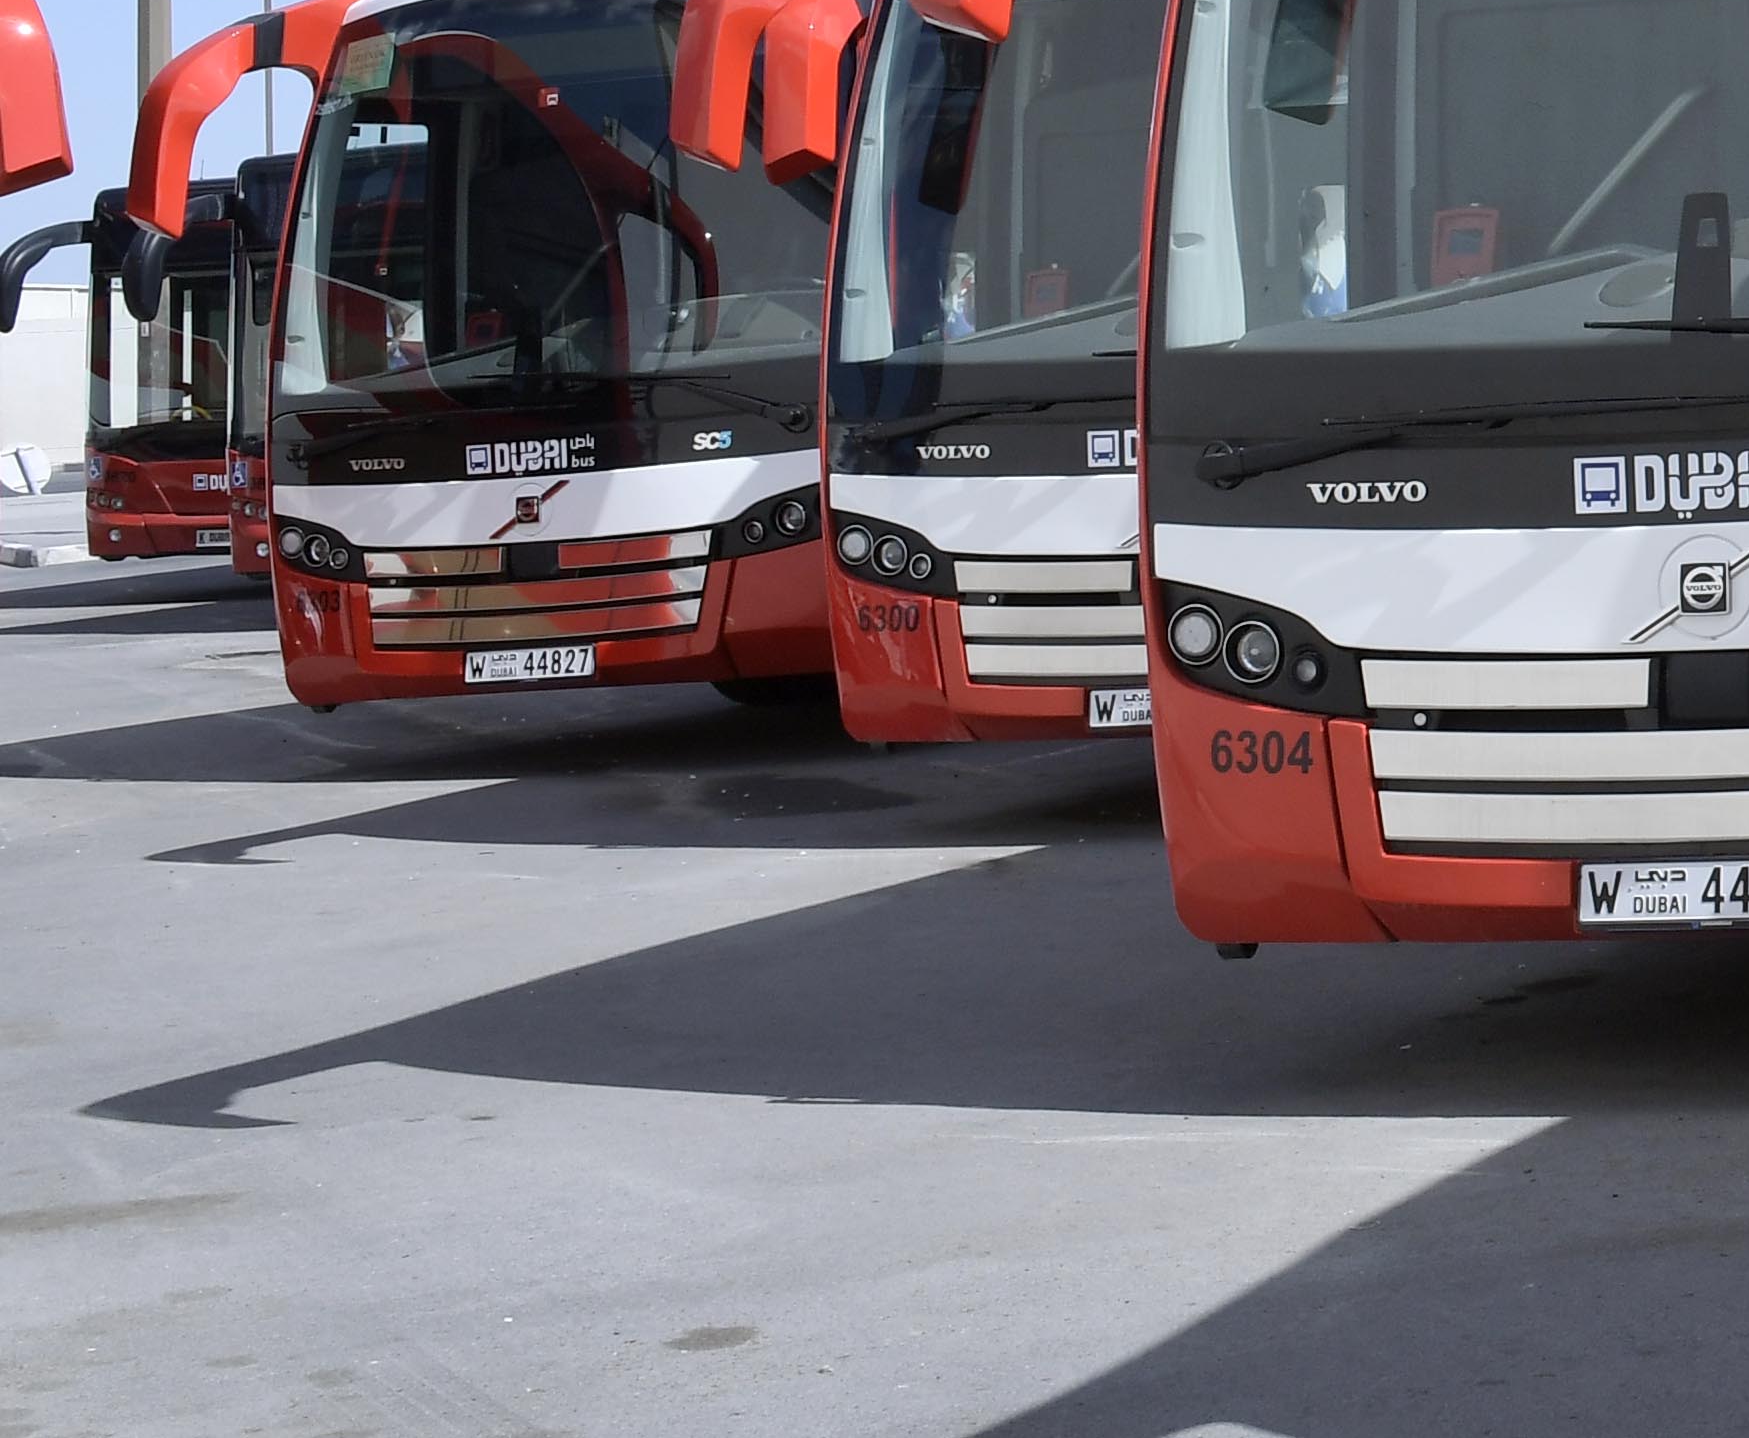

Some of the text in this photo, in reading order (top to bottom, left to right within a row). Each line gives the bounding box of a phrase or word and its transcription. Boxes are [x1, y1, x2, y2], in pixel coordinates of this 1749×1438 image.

[570, 433, 595, 451] باص
[692, 430, 733, 451] SC5
[494, 438, 568, 476] DUBAI
[571, 455, 595, 468] bus
[916, 444, 991, 460] VOLVO
[349, 458, 405, 471] VOLVO
[1307, 480, 1427, 505] VOLVO
[1685, 584, 1721, 592] VOLVO
[857, 604, 920, 633] 6300
[469, 654, 486, 679] W
[490, 667, 517, 678] DUBAI
[523, 649, 589, 677] 44827
[1095, 694, 1116, 722] W
[1210, 730, 1313, 774] 6304
[1634, 869, 1687, 890] دبي
[1588, 871, 1622, 914] W
[1633, 896, 1687, 914] DUBAI
